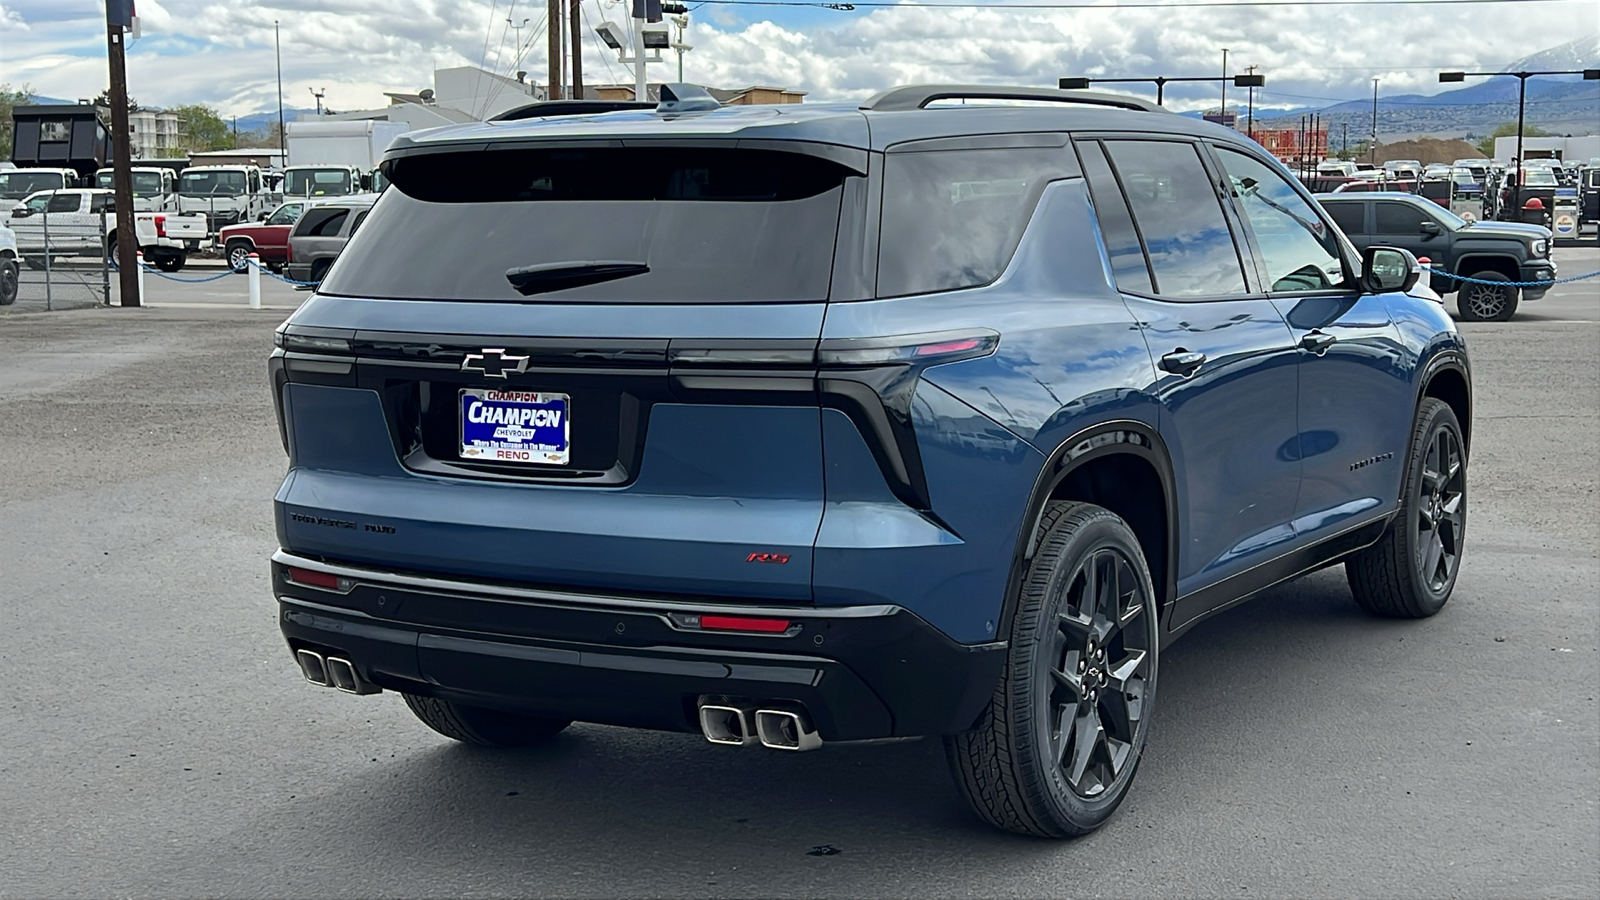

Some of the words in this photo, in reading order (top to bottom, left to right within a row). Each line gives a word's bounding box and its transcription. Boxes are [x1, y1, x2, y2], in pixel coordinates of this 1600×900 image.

[487, 391, 538, 402] CHAMPION
[496, 429, 532, 437] CHEVROLET
[496, 450, 529, 460] RENO
[745, 552, 791, 564] RS
